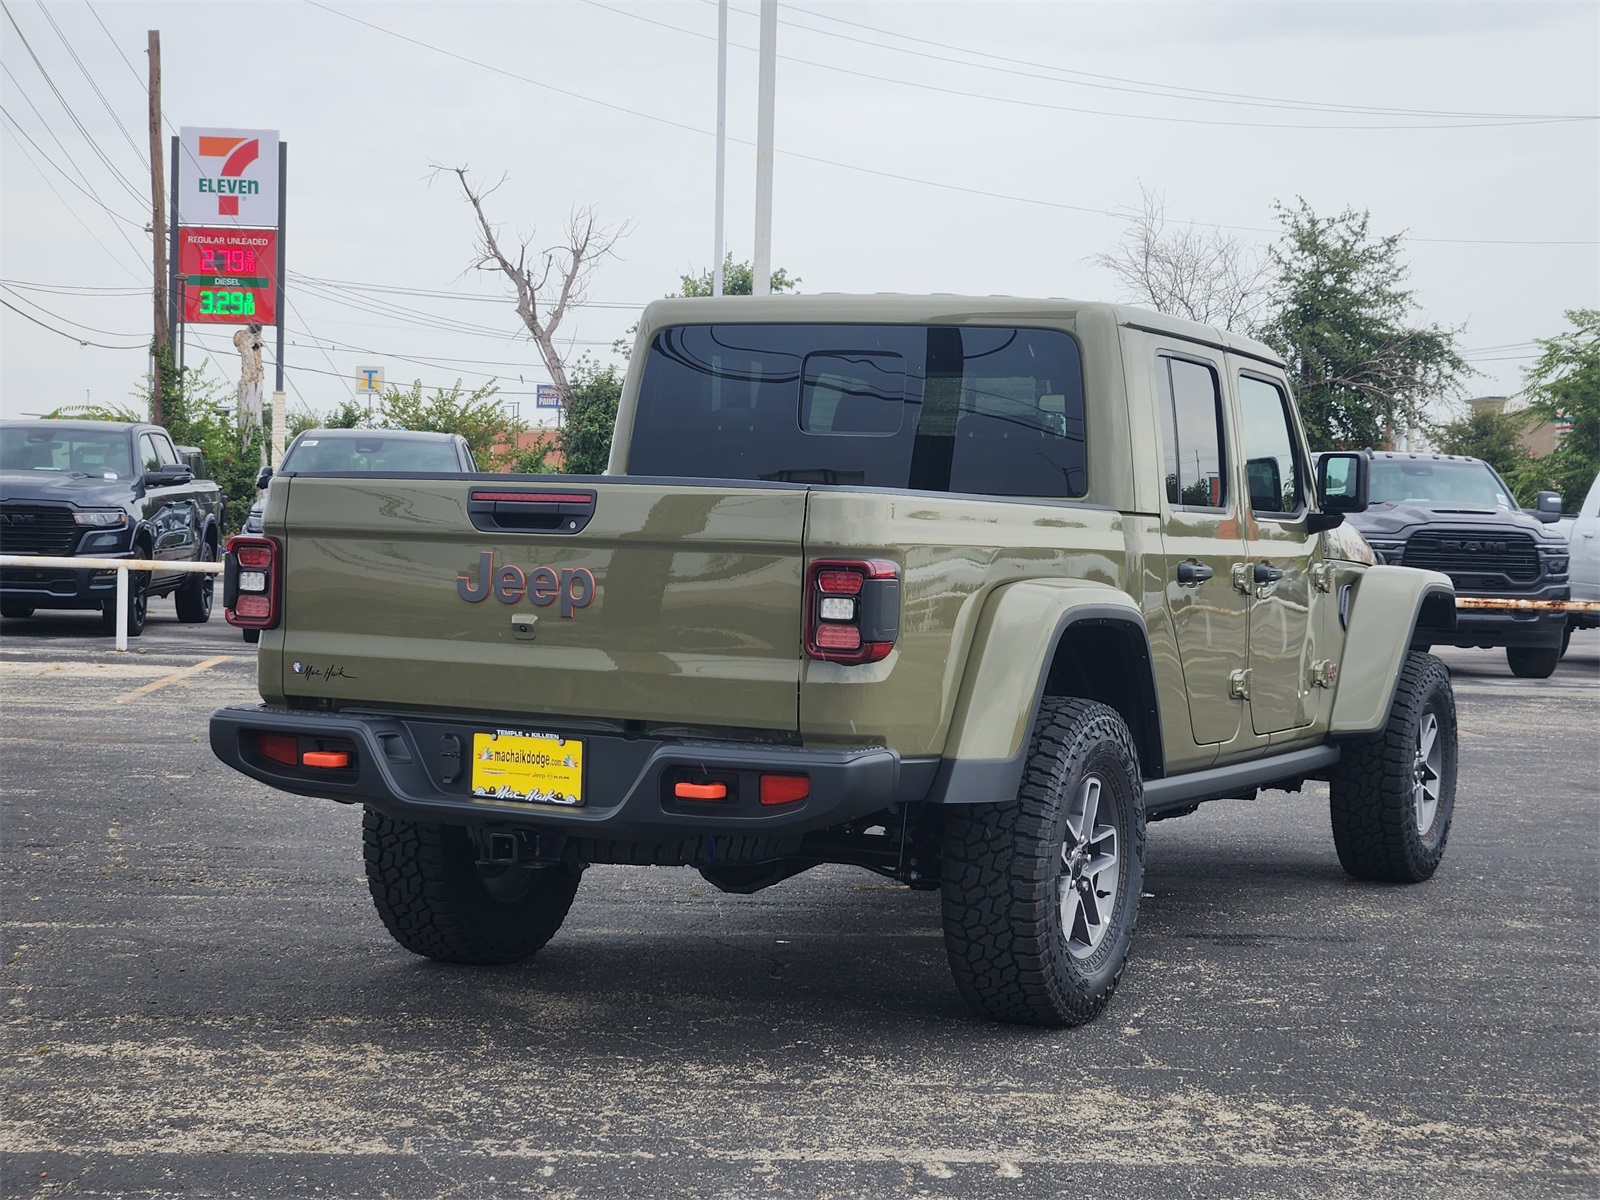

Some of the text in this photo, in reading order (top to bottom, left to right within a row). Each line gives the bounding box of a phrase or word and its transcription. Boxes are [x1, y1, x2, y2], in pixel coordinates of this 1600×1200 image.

[188, 235, 268, 246] REGULAR UNLEADED
[214, 278, 240, 286] DIESEL
[1440, 540, 1507, 552] RAM
[457, 550, 597, 618] Jeep
[497, 729, 560, 740] TEMPLE KILLEEN
[494, 749, 562, 768] machaikdodge.com
[495, 785, 556, 802] Mac Haik
